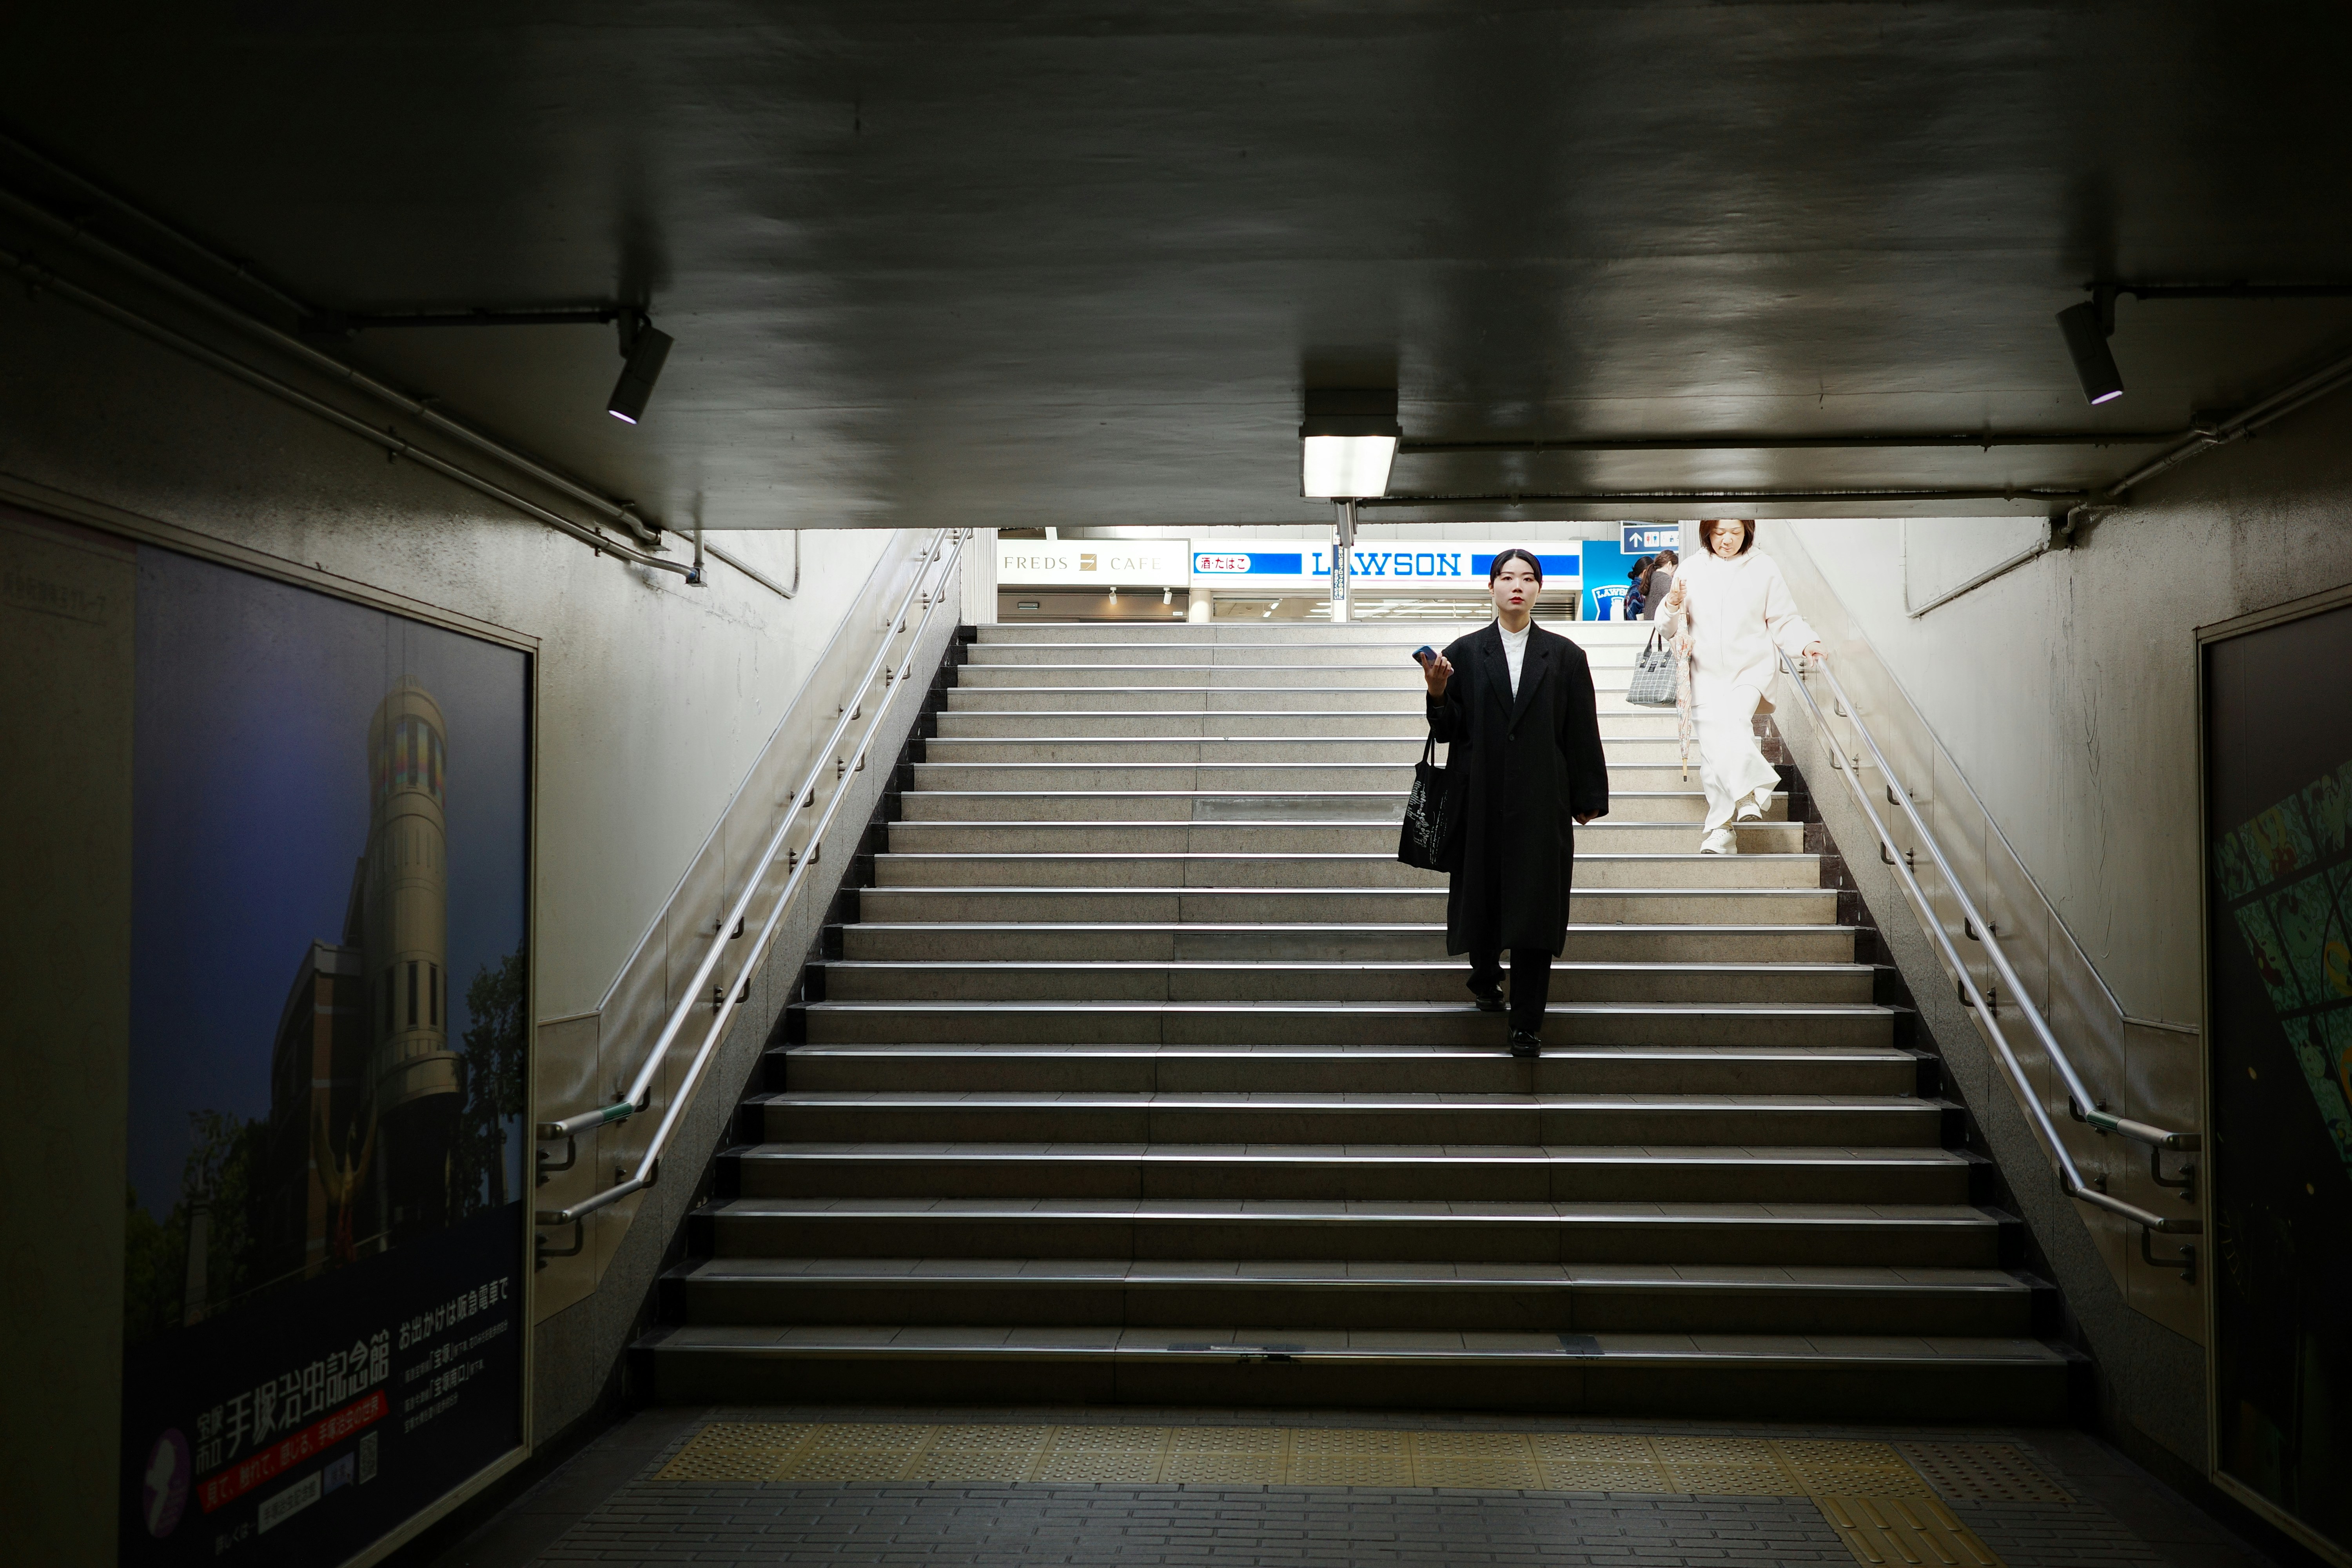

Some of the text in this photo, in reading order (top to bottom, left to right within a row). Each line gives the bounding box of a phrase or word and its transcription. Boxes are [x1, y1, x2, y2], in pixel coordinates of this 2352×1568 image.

[1004, 557, 1161, 570] FREDS CAFE
[398, 1276, 509, 1351] お出かけは阪急電車で
[225, 1328, 390, 1459] 手塚治虫記念館
